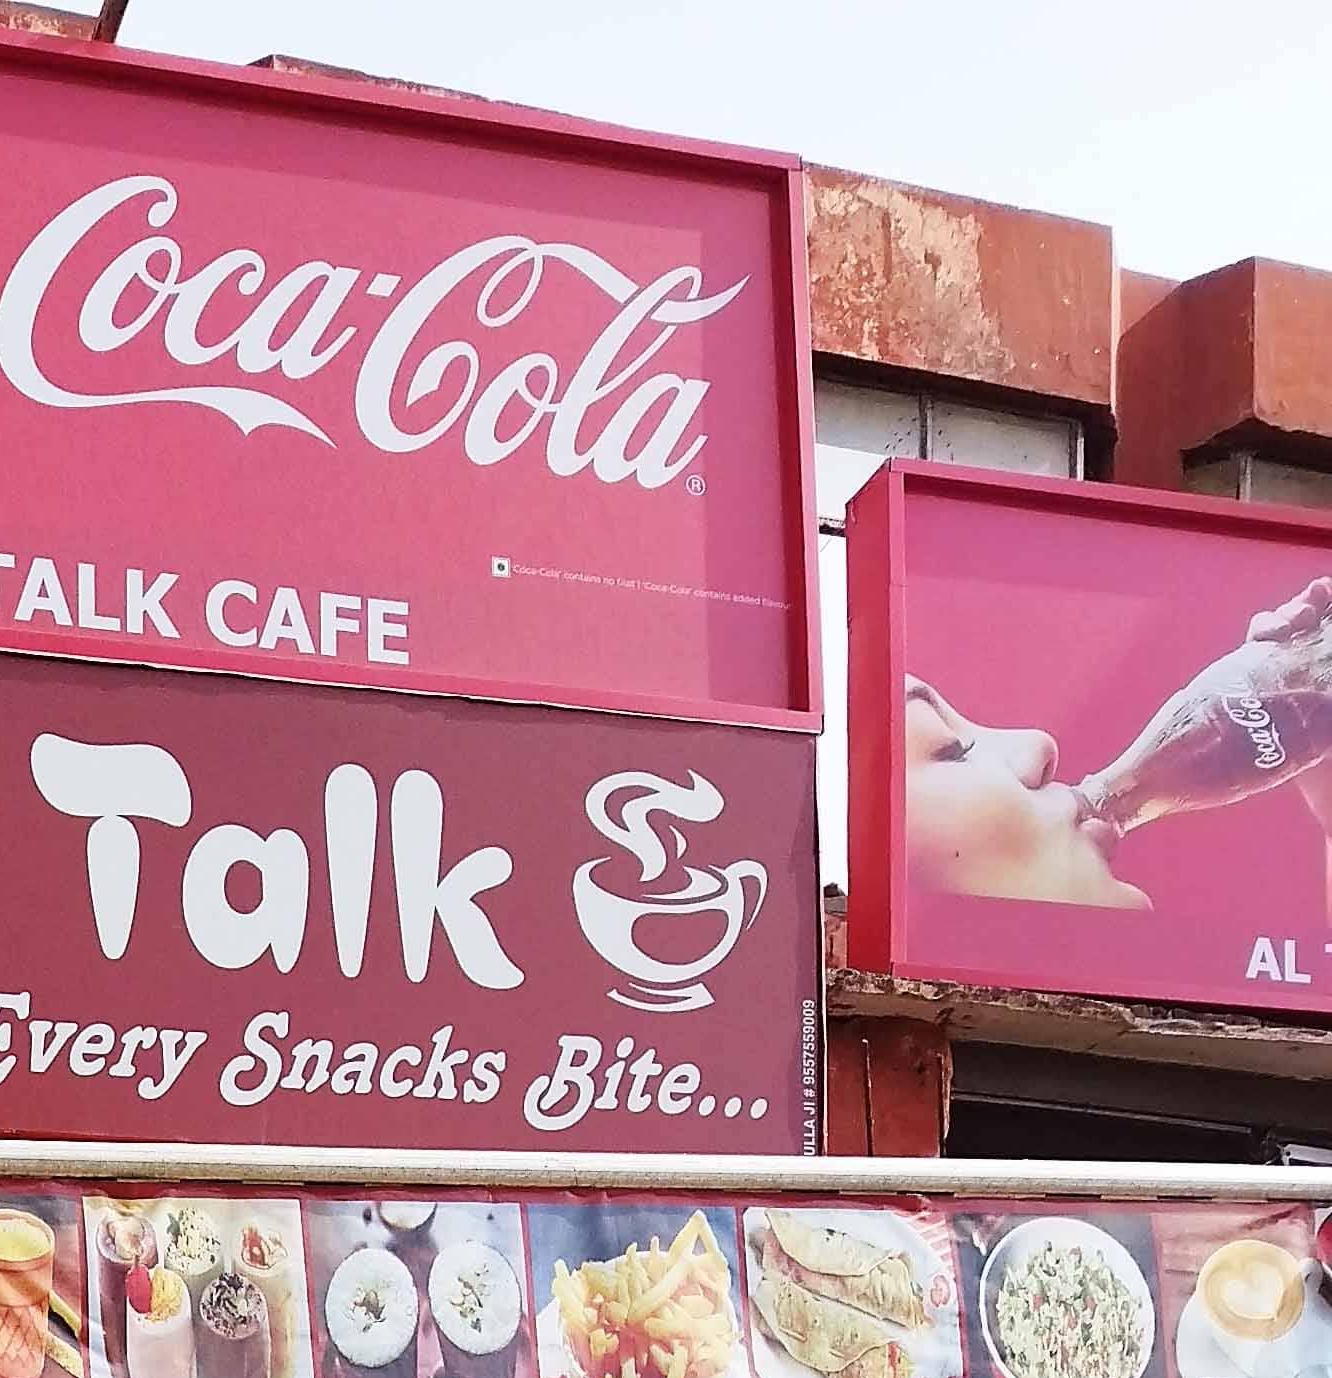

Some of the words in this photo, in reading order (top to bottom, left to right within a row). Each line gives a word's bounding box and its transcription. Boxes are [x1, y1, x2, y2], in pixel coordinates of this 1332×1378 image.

[204, 579, 412, 666] CAFE
[31, 733, 525, 990] Talk
[1246, 937, 1311, 984] AL
[219, 1011, 506, 1107] Snacks
[524, 1034, 769, 1130] Bite...
[803, 1000, 816, 1085] 9557559009
[803, 1101, 816, 1116] JI
